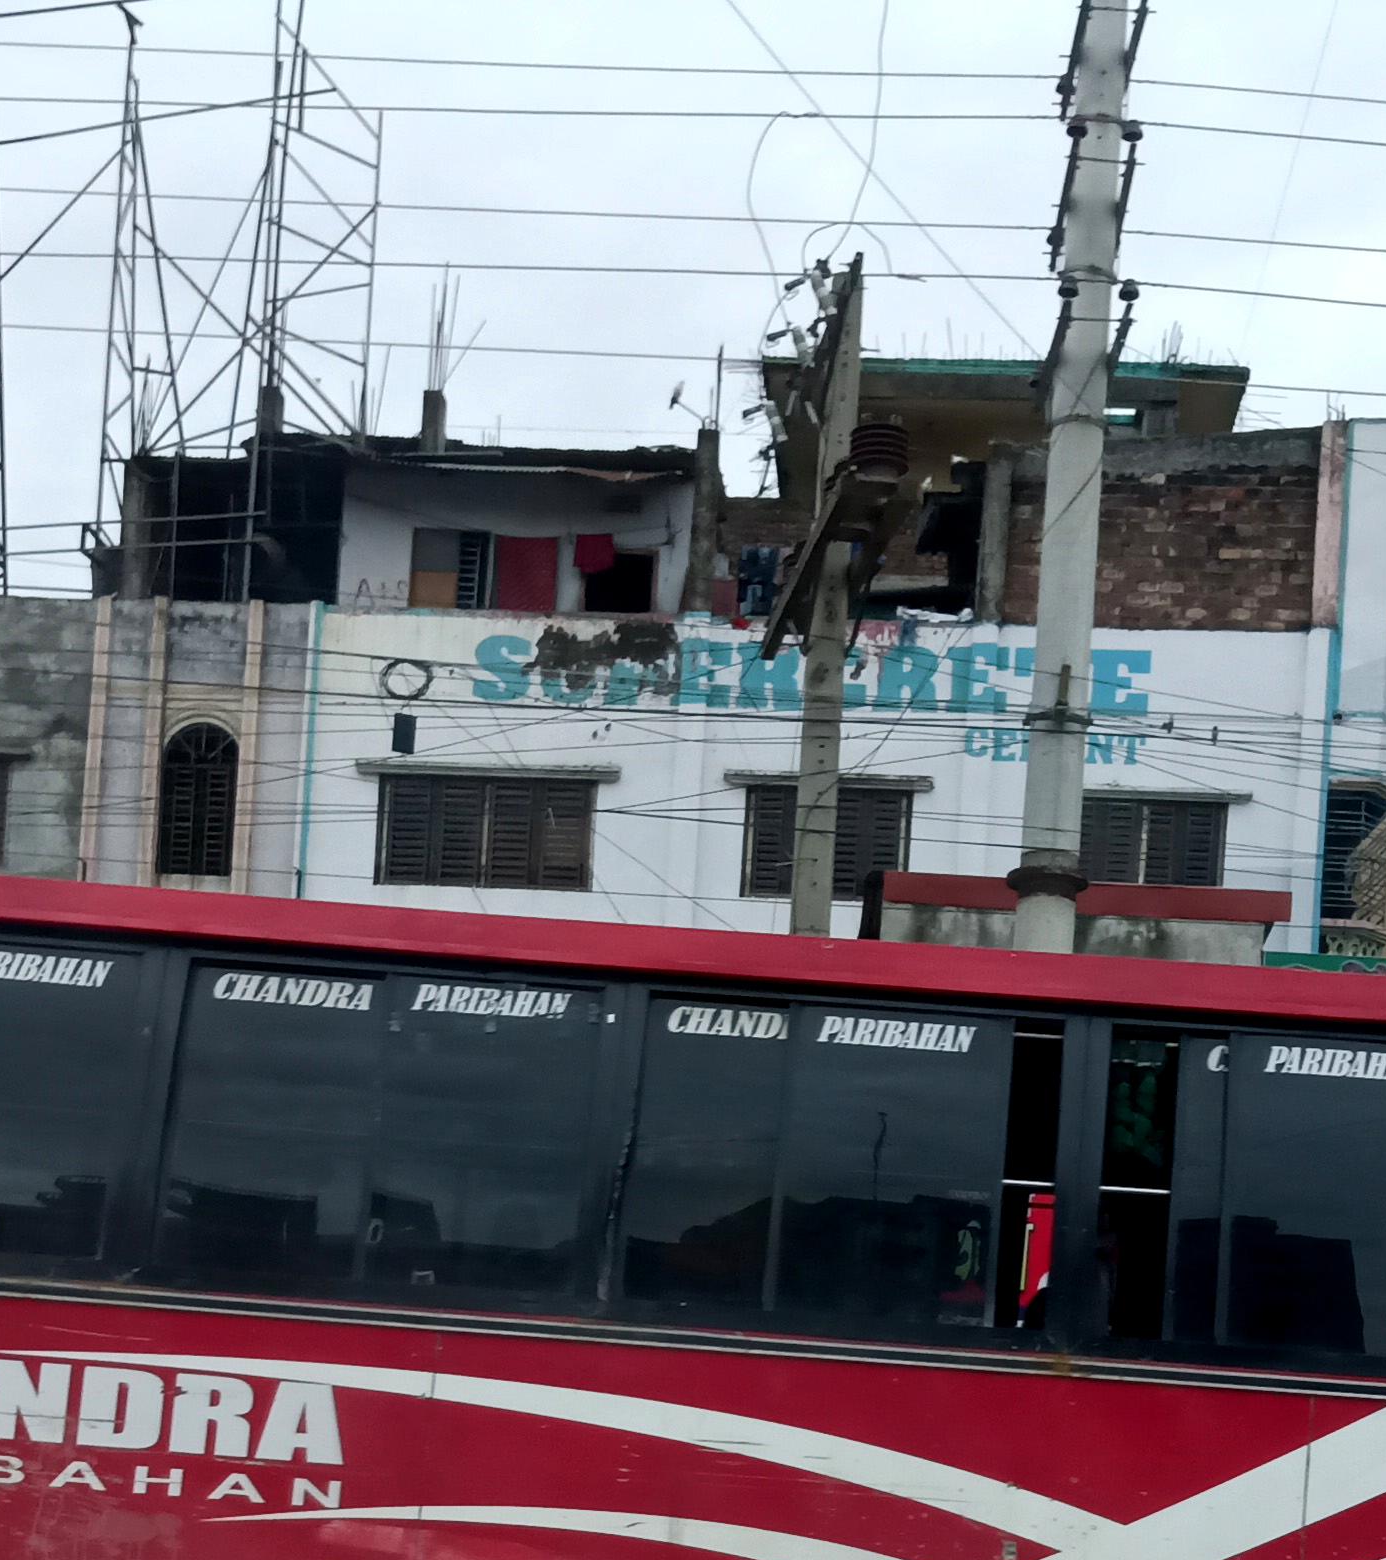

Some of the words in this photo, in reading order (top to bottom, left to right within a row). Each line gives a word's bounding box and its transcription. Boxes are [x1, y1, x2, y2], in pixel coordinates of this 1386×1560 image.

[963, 727, 1147, 766] CENT
[213, 972, 374, 1011] CHANDRA
[410, 983, 573, 1020] PARIBAHAN
[816, 1015, 978, 1053] PARIBAHAN
